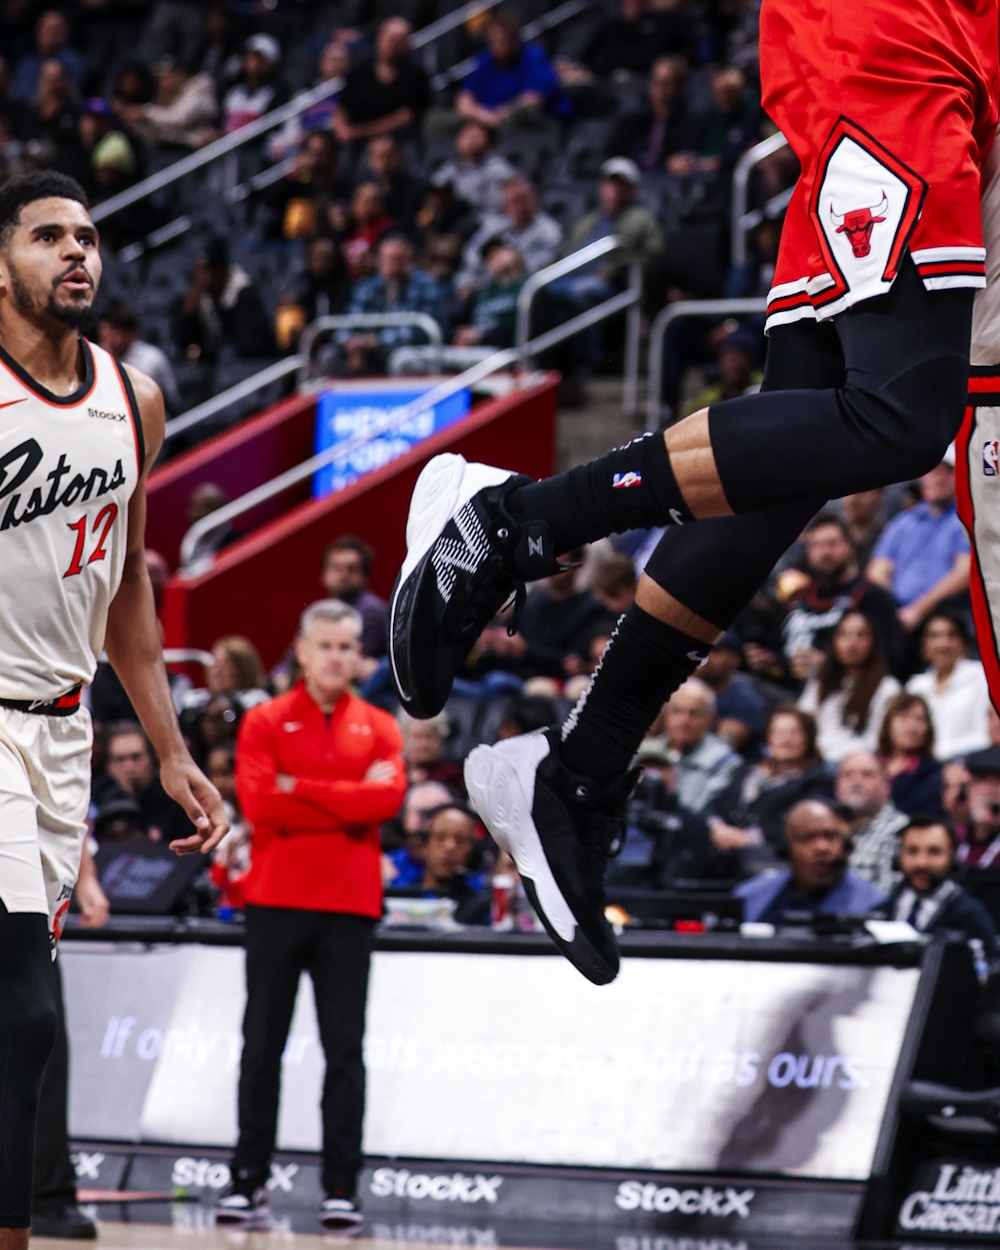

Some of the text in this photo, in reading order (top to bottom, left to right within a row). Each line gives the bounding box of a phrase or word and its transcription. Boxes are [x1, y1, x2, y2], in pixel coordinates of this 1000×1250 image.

[87, 407, 127, 423] StockX
[63, 503, 118, 579] 12
[369, 1167, 503, 1204] StockX
[615, 1179, 755, 1218] StockX
